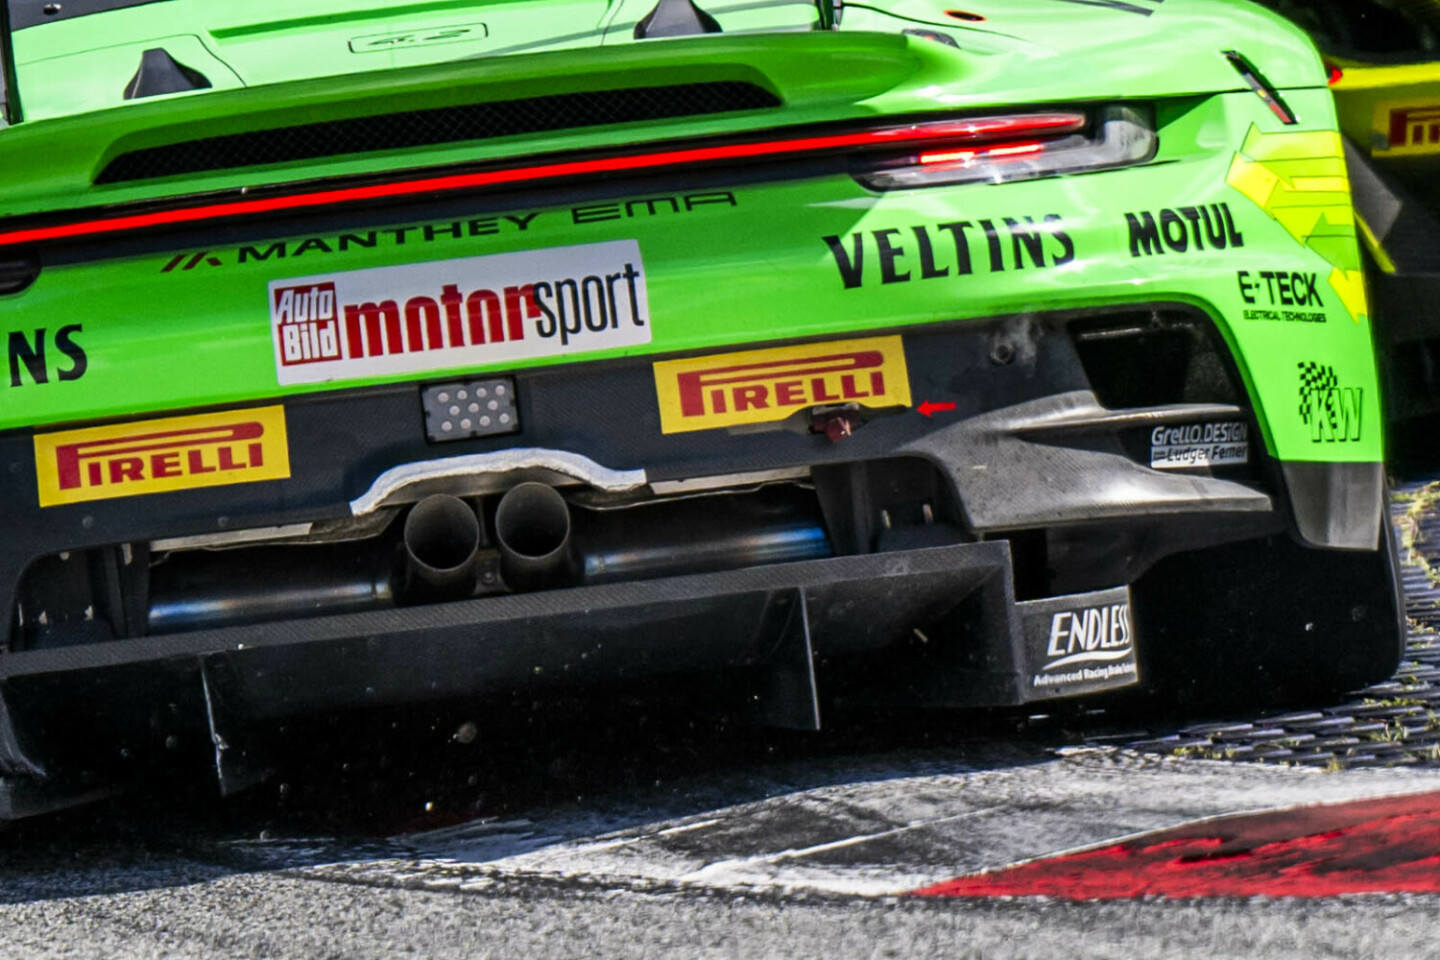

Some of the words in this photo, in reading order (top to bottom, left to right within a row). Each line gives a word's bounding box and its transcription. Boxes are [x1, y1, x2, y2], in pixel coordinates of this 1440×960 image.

[237, 213, 538, 264] MANTHEY
[571, 191, 737, 225] EMA
[822, 214, 1076, 290] VELTINS
[1124, 202, 1243, 258] MOTUL
[277, 287, 334, 324] Auto
[1237, 271, 1324, 308] E-TECK
[283, 321, 339, 363] Bild
[677, 350, 885, 418] PIRELLI
[1310, 388, 1363, 443] KW
[55, 421, 264, 491] PIRELLI
[1047, 604, 1131, 656] ENDLESS
[1034, 669, 1083, 687] Advanced
